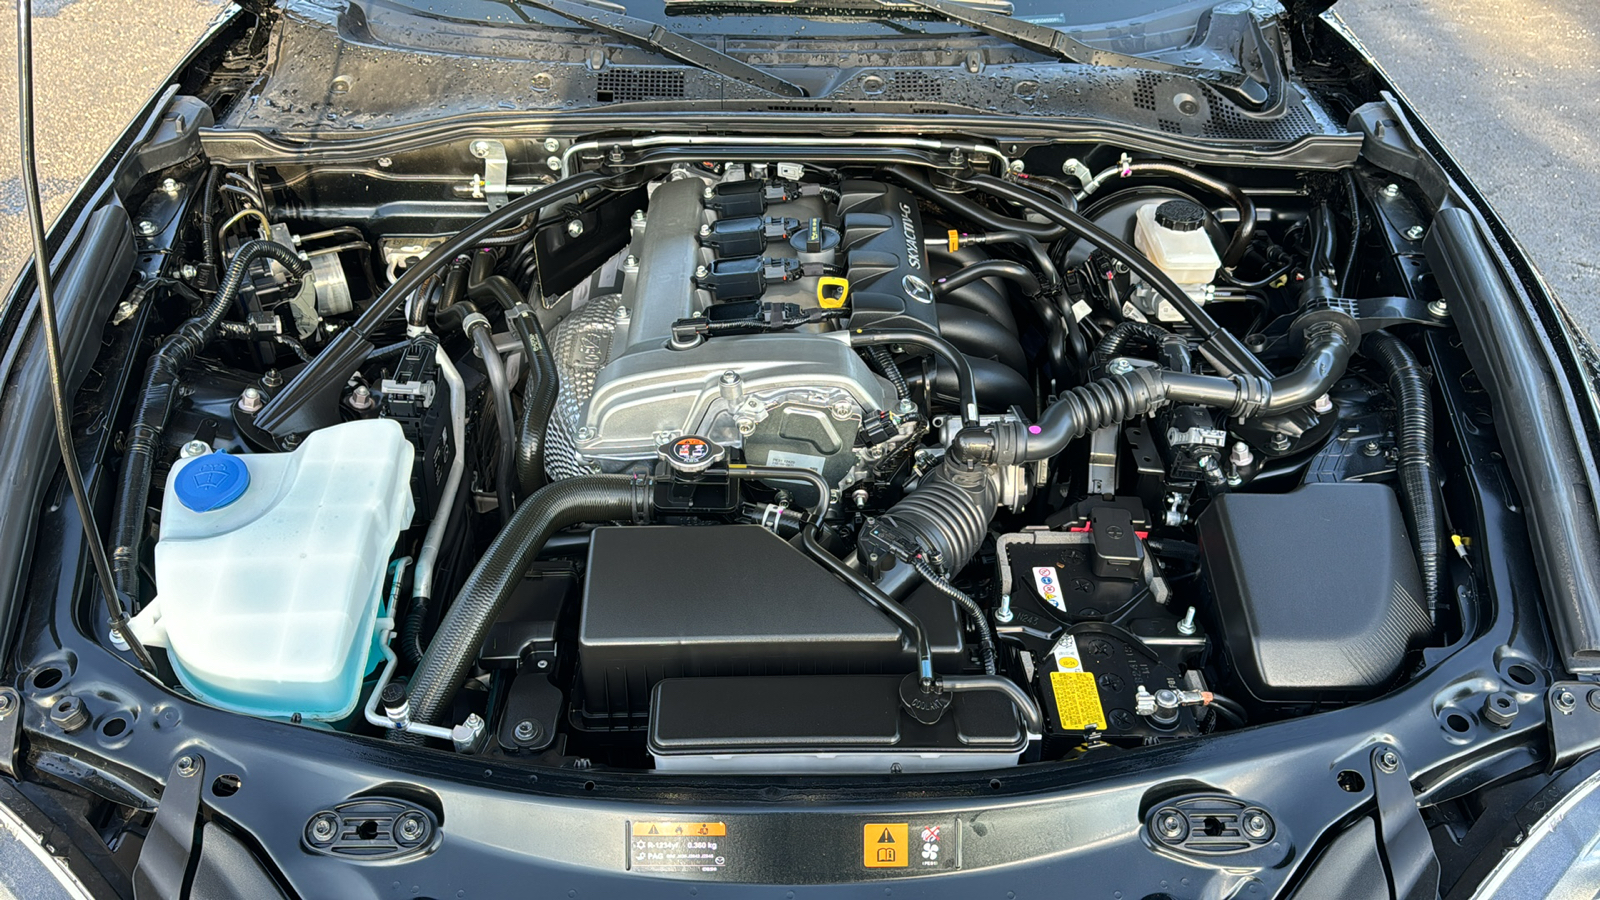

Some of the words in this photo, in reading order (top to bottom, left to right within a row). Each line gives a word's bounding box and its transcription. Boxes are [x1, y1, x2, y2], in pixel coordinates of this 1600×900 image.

[899, 202, 922, 270] SKYACTIV-G
[1016, 612, 1040, 626] N243
[911, 698, 943, 711] COOLANT
[647, 841, 679, 850] R-1234yf
[707, 841, 718, 850] kg
[647, 852, 664, 860] PAG
